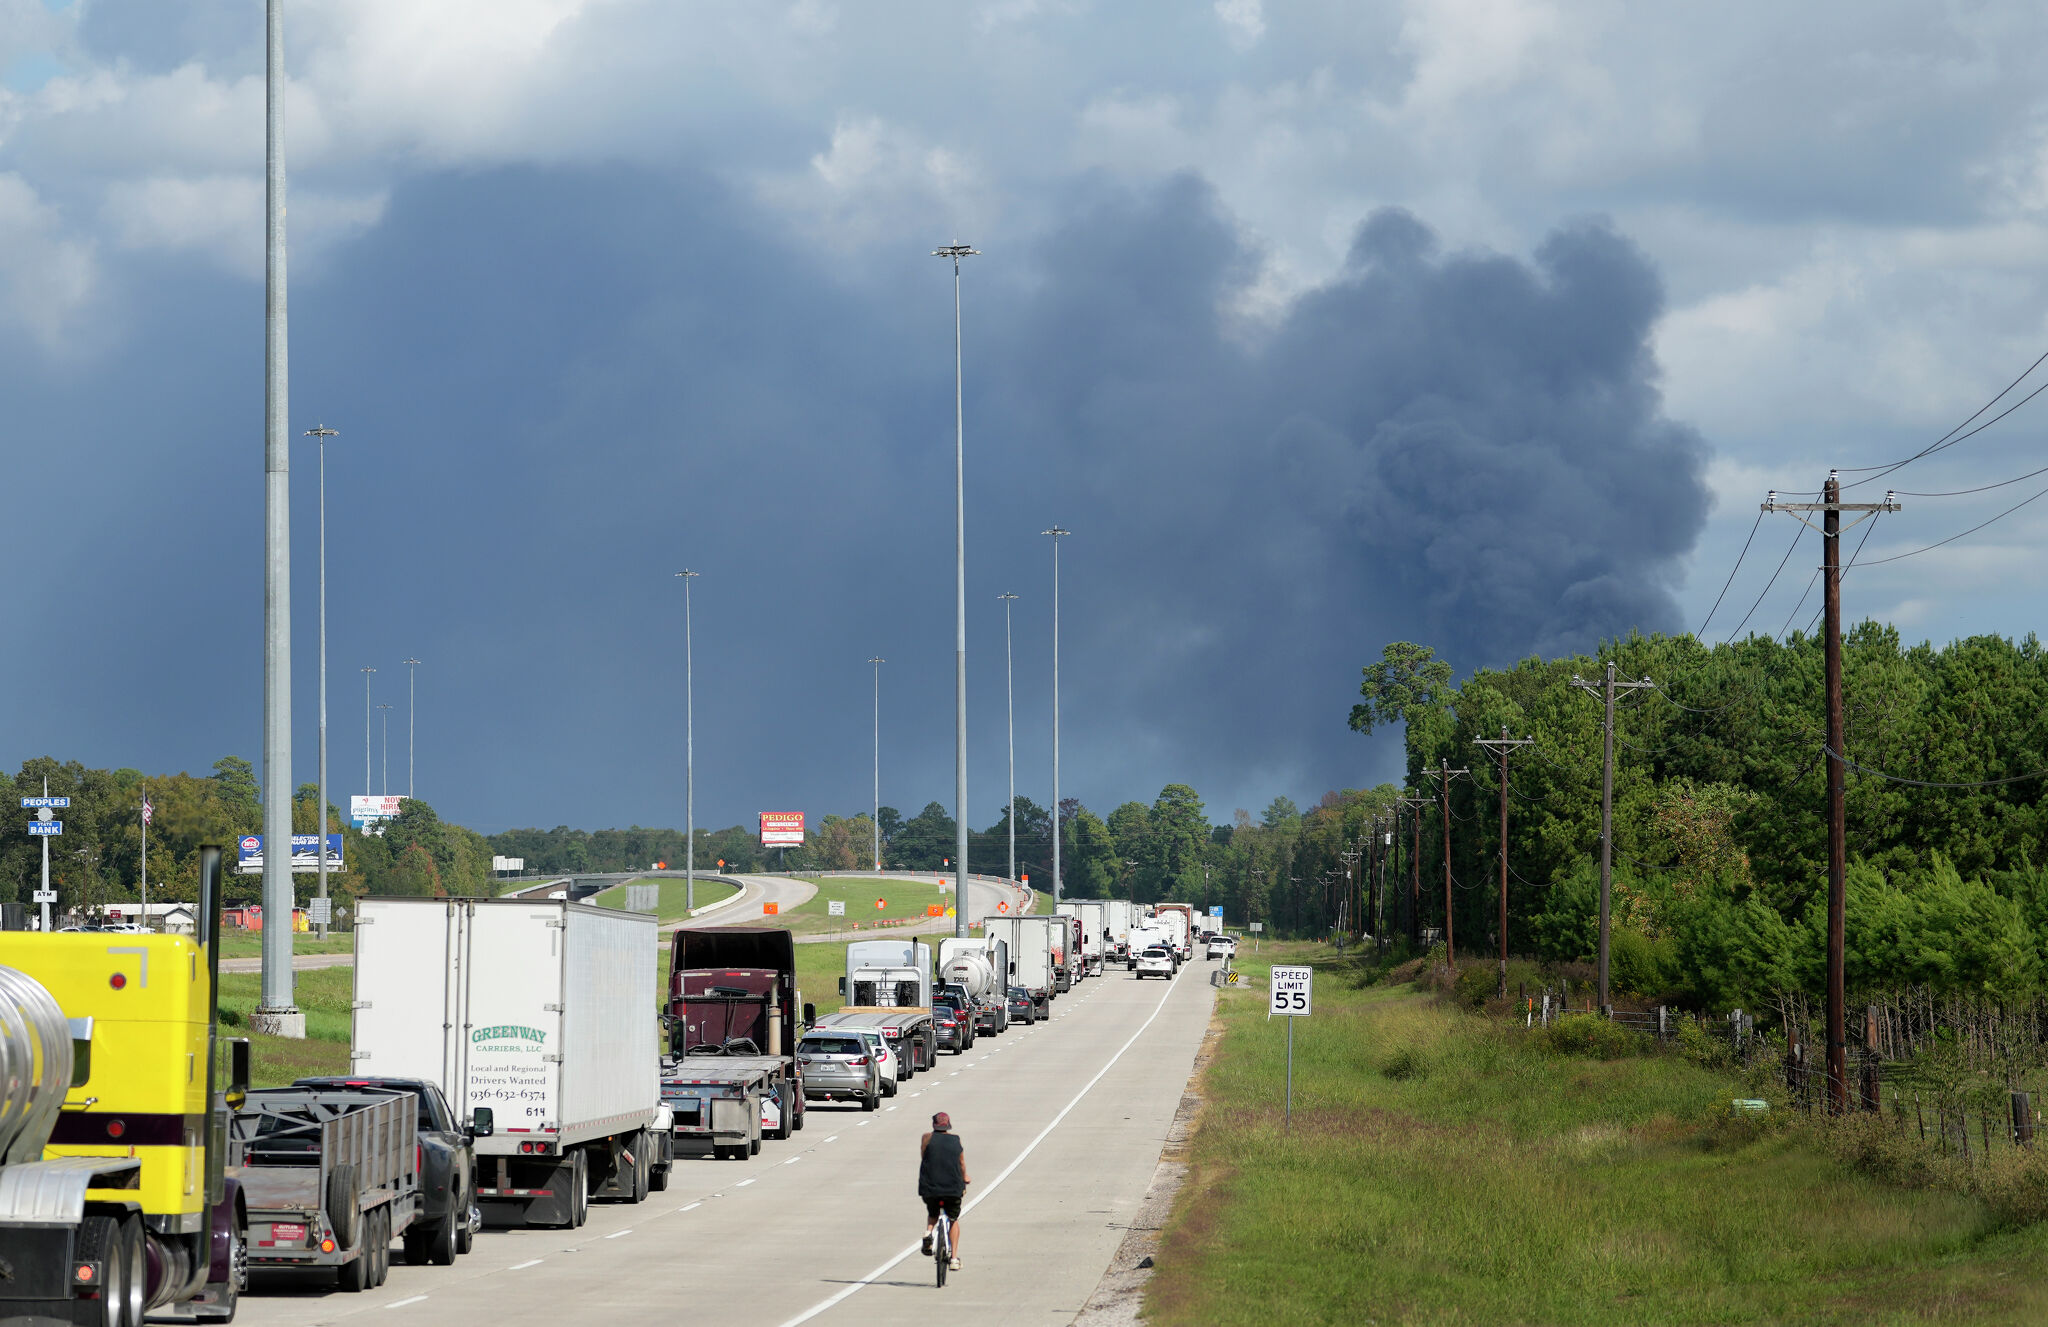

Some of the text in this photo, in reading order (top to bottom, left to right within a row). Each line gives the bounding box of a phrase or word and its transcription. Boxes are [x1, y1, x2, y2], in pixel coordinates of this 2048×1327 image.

[23, 798, 66, 806] PEOPLES
[30, 826, 59, 834] BANK
[1274, 971, 1309, 980] SPEED
[1278, 982, 1304, 990] LIMIT
[1275, 992, 1306, 1010] 55
[471, 1025, 547, 1044] GREENWAY
[476, 1045, 542, 1053] CARRIERS, LLC
[511, 1065, 547, 1074] Regional
[470, 1076, 546, 1085] Drivers Wanted
[470, 1088, 546, 1101] 936-632-6374
[526, 1107, 545, 1117] 614
